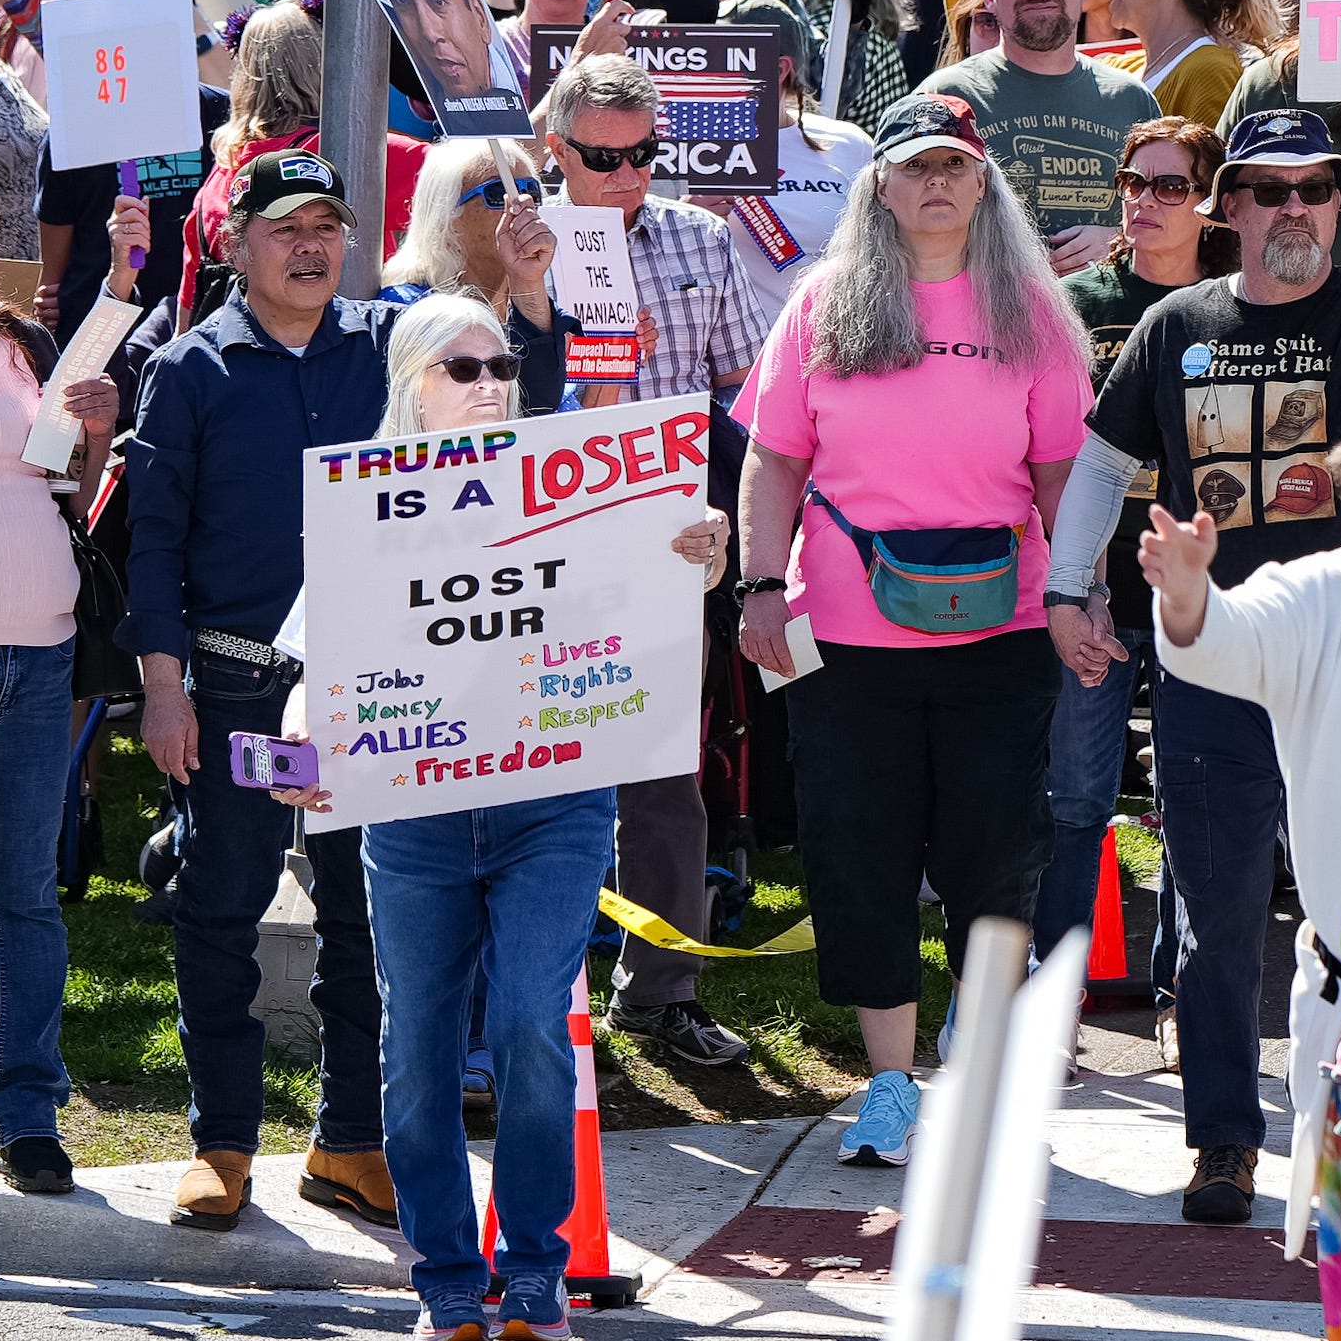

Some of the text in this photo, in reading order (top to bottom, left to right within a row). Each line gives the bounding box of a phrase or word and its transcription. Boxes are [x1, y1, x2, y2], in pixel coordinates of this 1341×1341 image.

[727, 47, 756, 71] IN
[980, 115, 1120, 142] ONLY YOU CAN PREVENT
[1019, 143, 1046, 154] Visit
[1041, 156, 1103, 176] ENDOR
[1042, 189, 1109, 204] Lunar Forest
[574, 230, 606, 253] OUST
[587, 265, 612, 289] THE
[574, 301, 635, 327] MANIAC!!
[569, 342, 632, 358] Impeach Trump to
[1206, 339, 1266, 358] Same
[582, 358, 636, 373] the Constitution
[1294, 354, 1333, 375] Hat
[319, 429, 517, 483] TRUMP
[377, 411, 710, 521] IS A LOSER
[409, 558, 566, 609] LOST
[426, 606, 545, 647] OUR
[356, 669, 425, 694] Jobs
[539, 661, 633, 699] Rights
[349, 720, 467, 756] ALLIES
